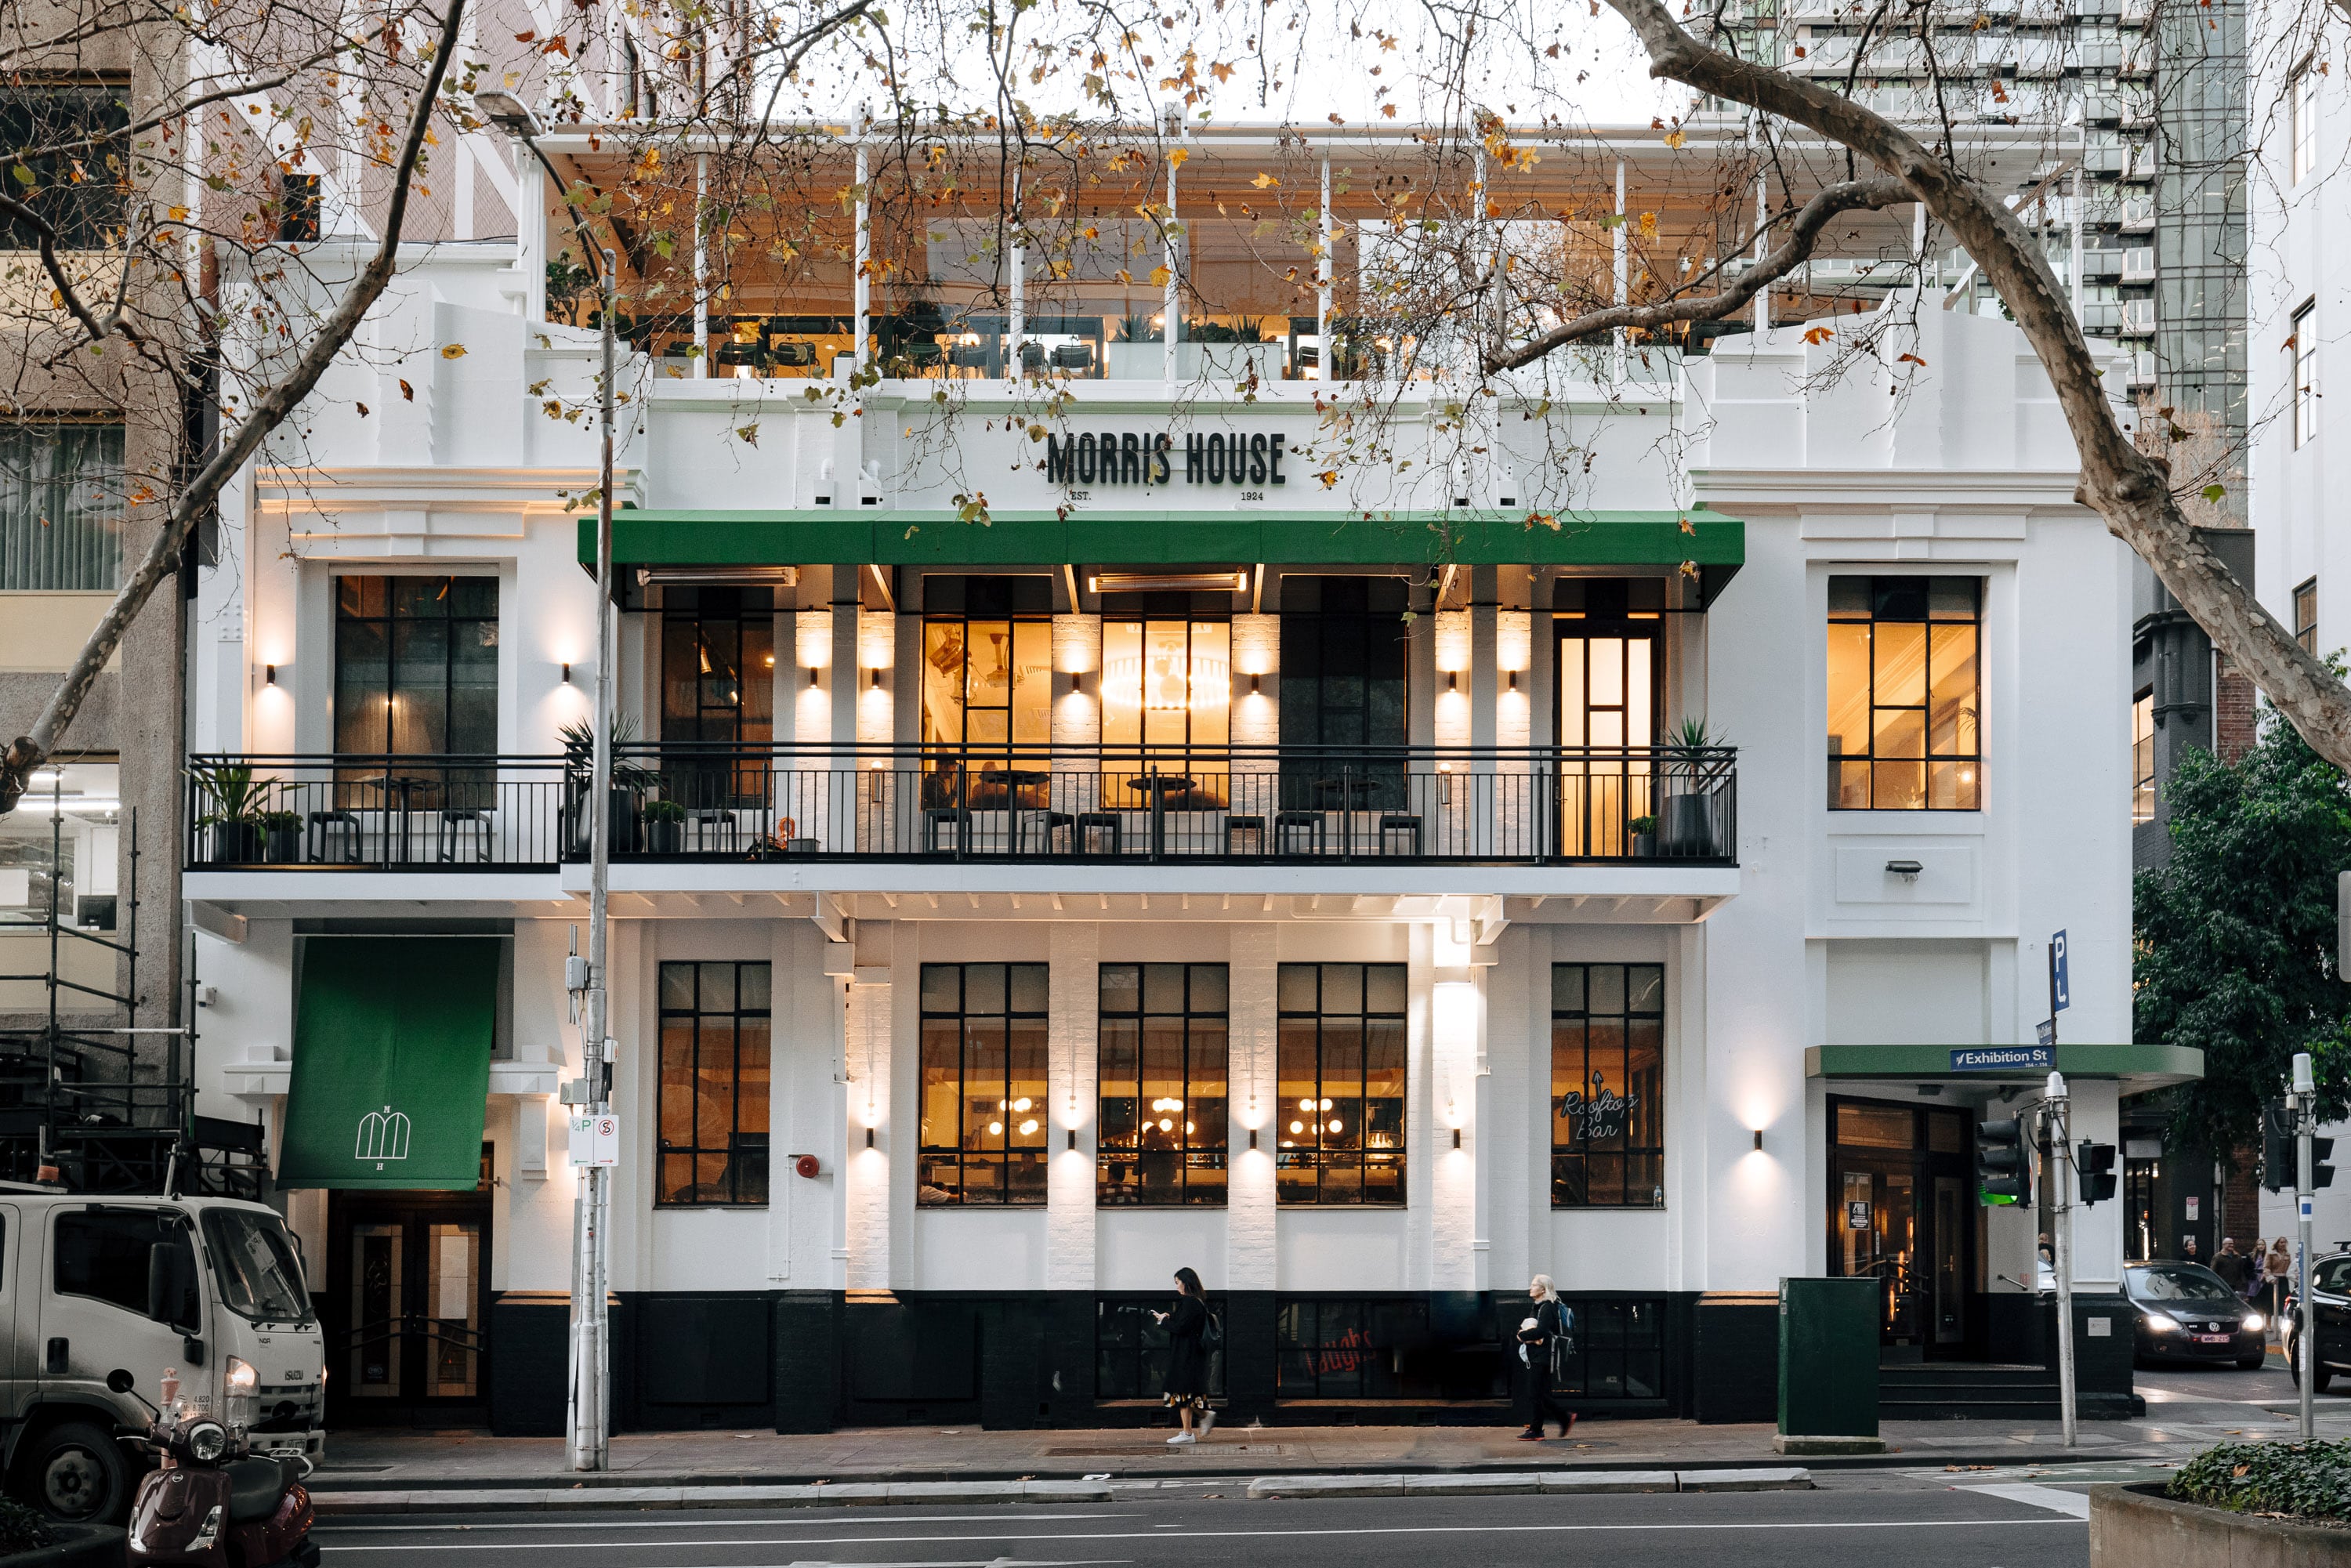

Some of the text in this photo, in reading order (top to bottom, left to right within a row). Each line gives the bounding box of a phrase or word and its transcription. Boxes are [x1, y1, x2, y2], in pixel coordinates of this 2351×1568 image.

[1047, 433, 1286, 484] MORRIS HOUSE
[1070, 491, 1263, 501] EST. 1924
[2055, 936, 2065, 972] P
[1965, 1049, 2048, 1064] Exhibition St
[1576, 1116, 1618, 1139] Bar
